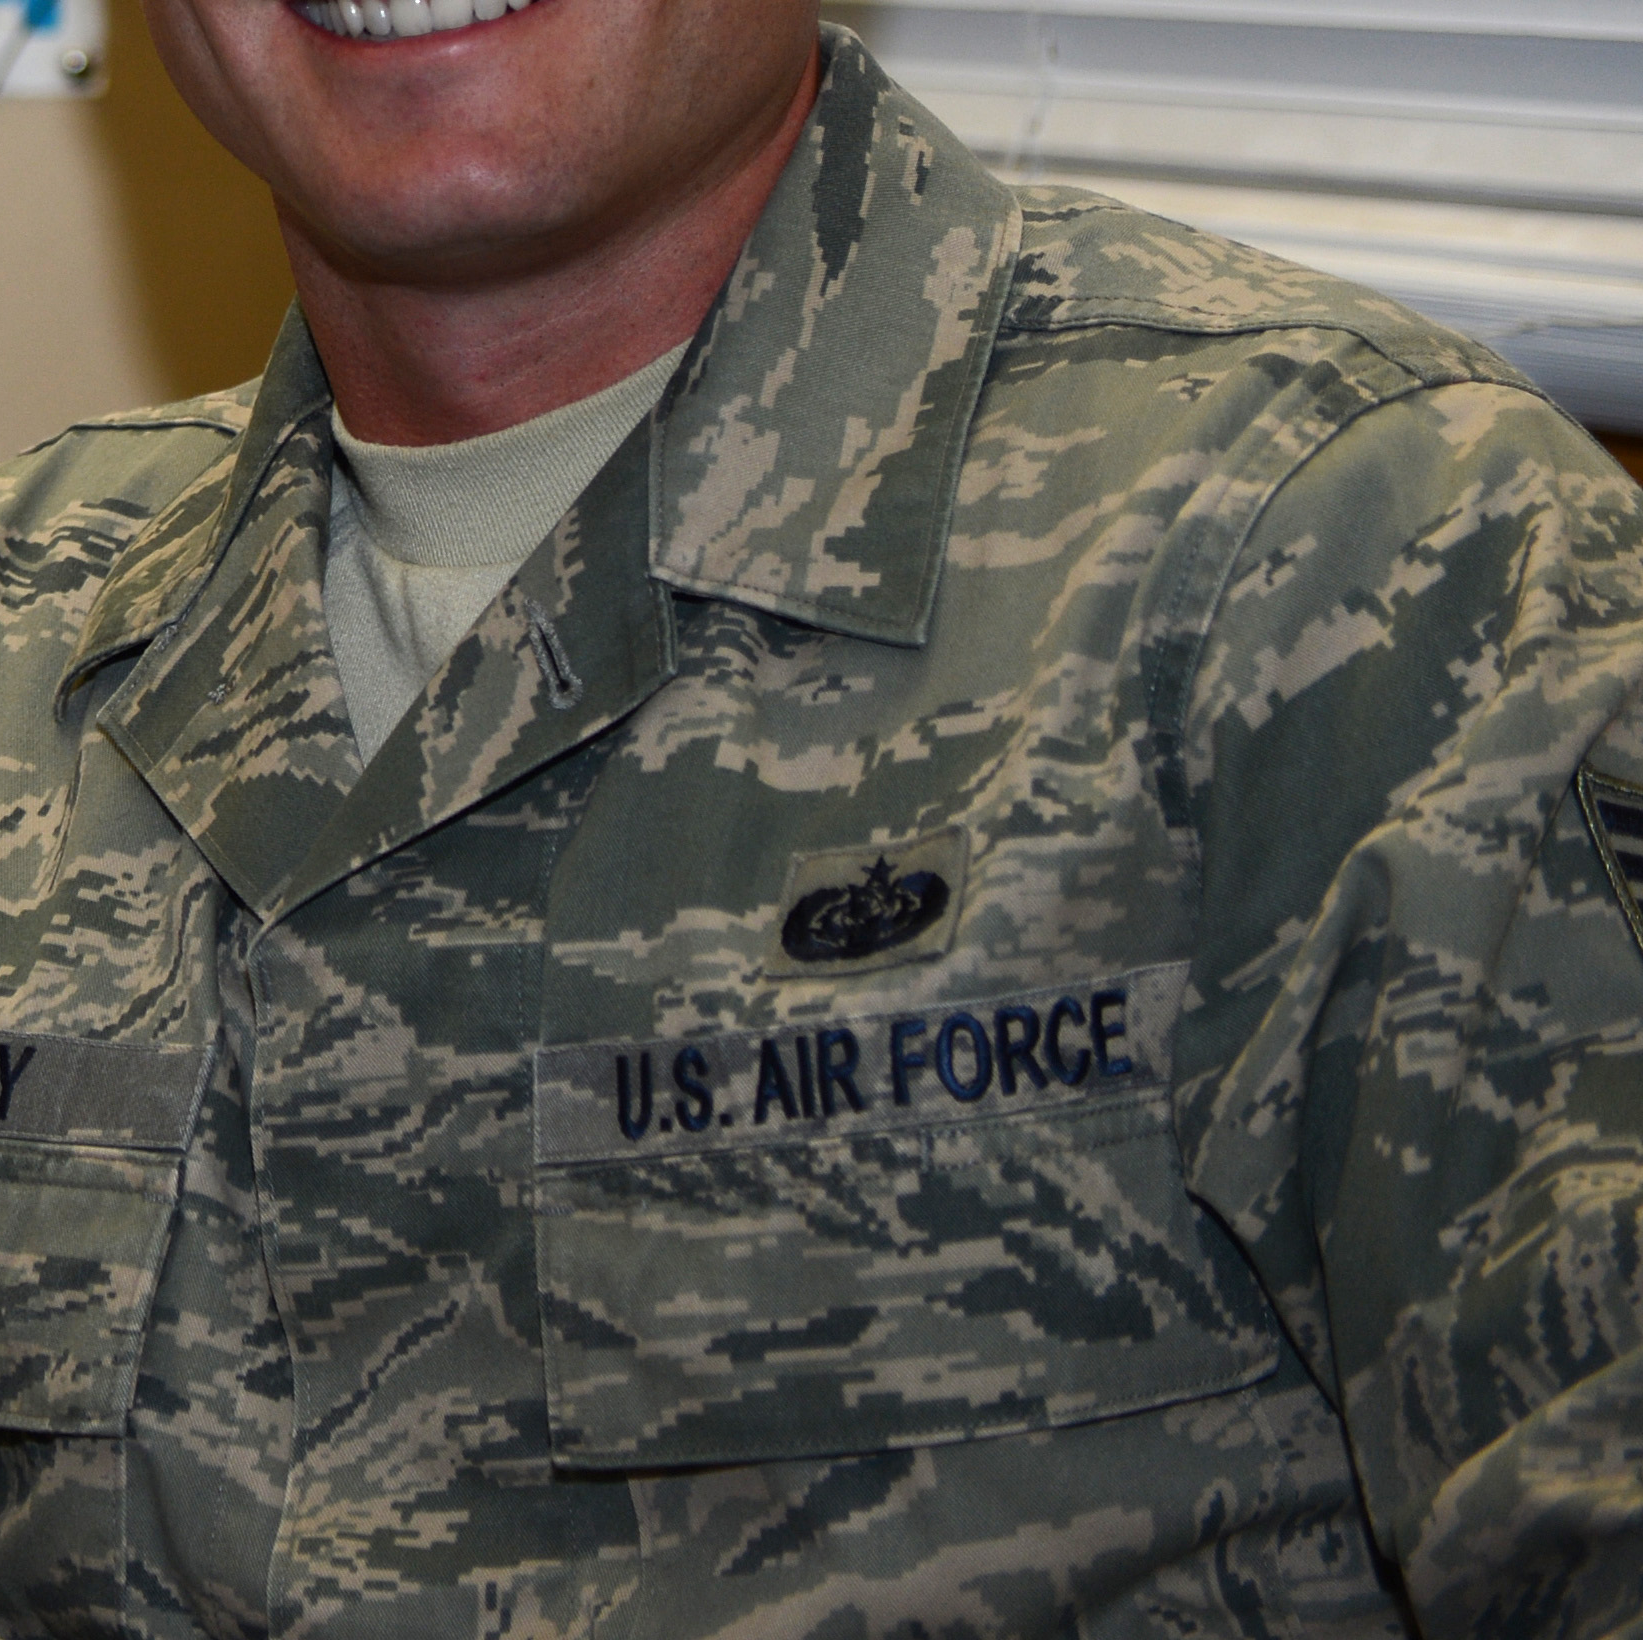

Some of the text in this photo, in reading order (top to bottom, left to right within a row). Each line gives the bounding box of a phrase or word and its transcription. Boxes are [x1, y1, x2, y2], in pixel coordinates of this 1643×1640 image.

[616, 988, 1132, 1140] U.S. AIR FORCE
